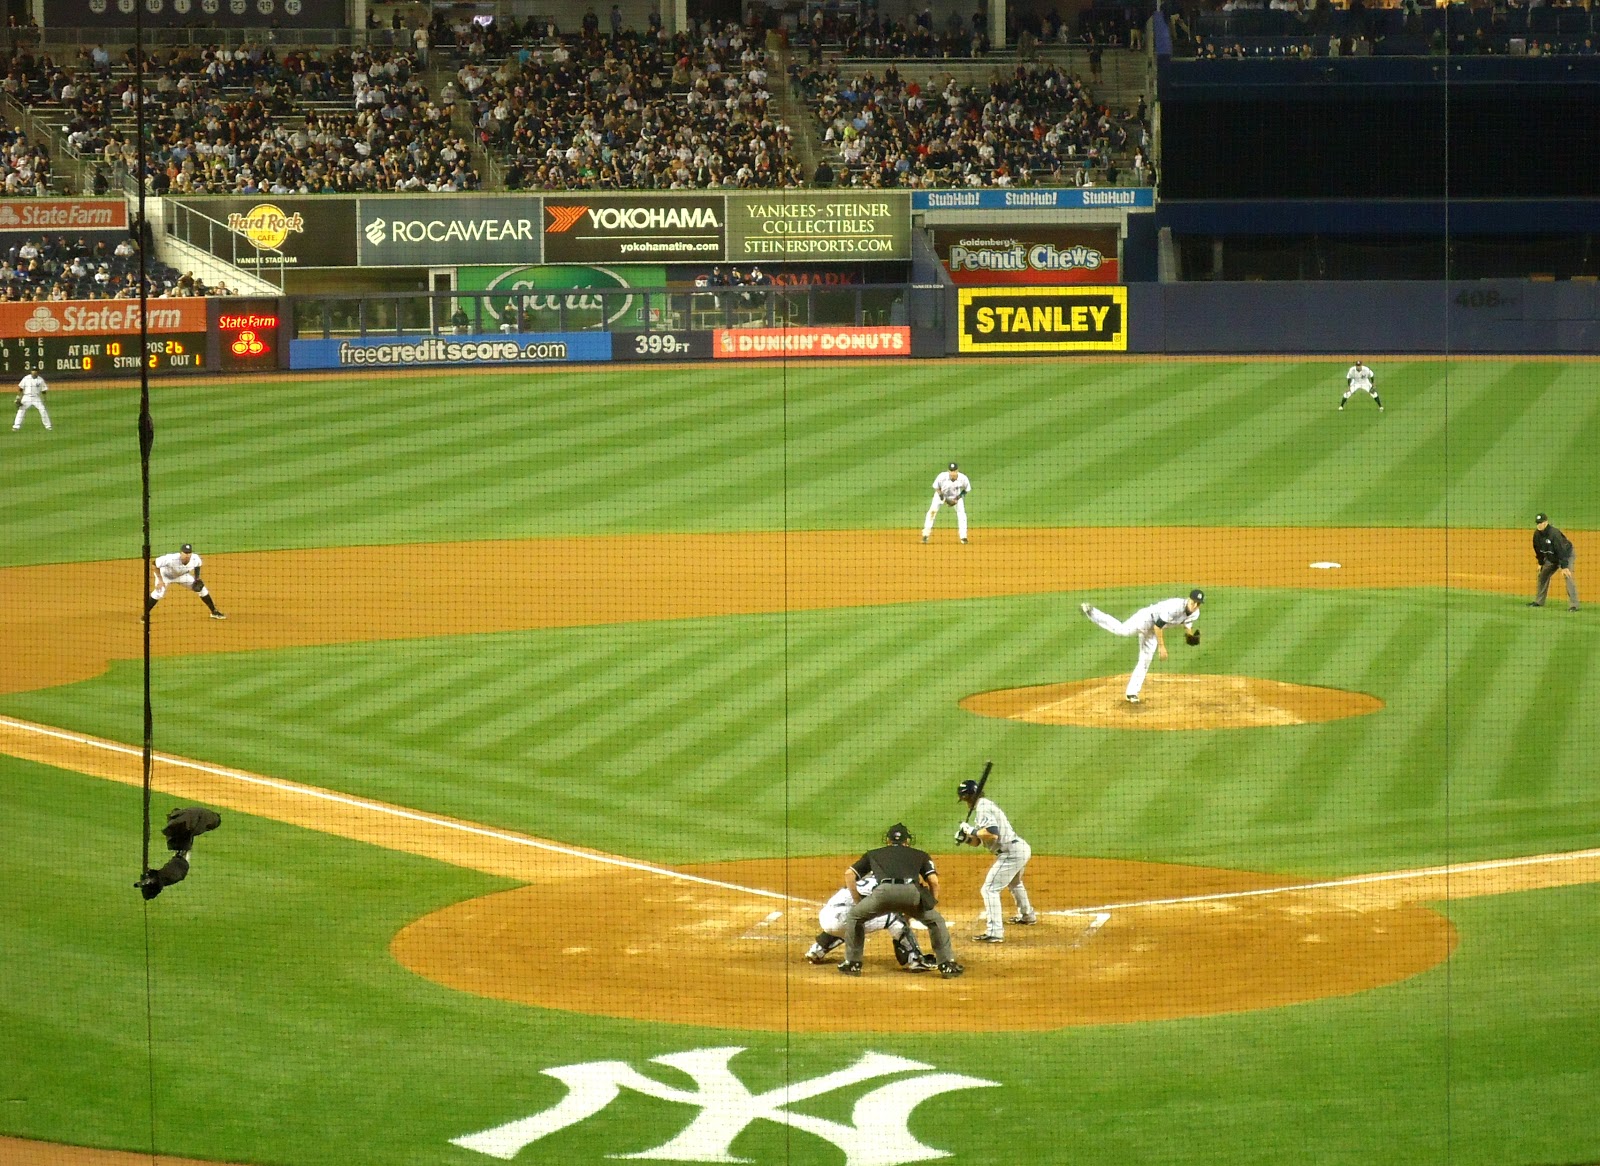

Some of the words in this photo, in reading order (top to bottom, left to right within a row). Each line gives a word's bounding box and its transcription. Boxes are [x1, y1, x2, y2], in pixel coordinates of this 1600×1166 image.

[150, 0, 160, 10] 10
[204, 1, 216, 10] 44
[287, 2, 299, 11] 42
[928, 192, 980, 206] StubHub!
[1005, 191, 1057, 205] StubHub!
[1082, 190, 1135, 205] StubHub!
[228, 213, 266, 231] Hard
[268, 211, 304, 233] Rock
[588, 207, 719, 229] YOKOHAMA
[392, 219, 533, 242] ROCAWEAR
[762, 219, 875, 233] COLLECTIBLES
[620, 242, 719, 253] yokohamatire.com
[744, 239, 893, 253] STEINERSPORTS.COM
[951, 245, 1027, 270] Peanut
[1029, 245, 1101, 269] Chews
[976, 306, 1110, 333] STANLEY
[38, 337, 44, 346] E
[68, 345, 80, 356] AT
[82, 344, 100, 356] BAT
[106, 342, 120, 356] 10
[165, 341, 183, 354] 26
[739, 335, 819, 352] DUNKIN'
[821, 333, 904, 350] DONUTS
[3, 348, 9, 358] 0
[24, 347, 30, 357] 2
[38, 347, 44, 356] 0
[4, 361, 9, 371] 1
[24, 360, 30, 371] 3
[38, 360, 44, 370] 0
[57, 358, 82, 370] BALL
[113, 356, 142, 368] STRIK
[148, 354, 157, 367] 2
[170, 354, 190, 366] OUT
